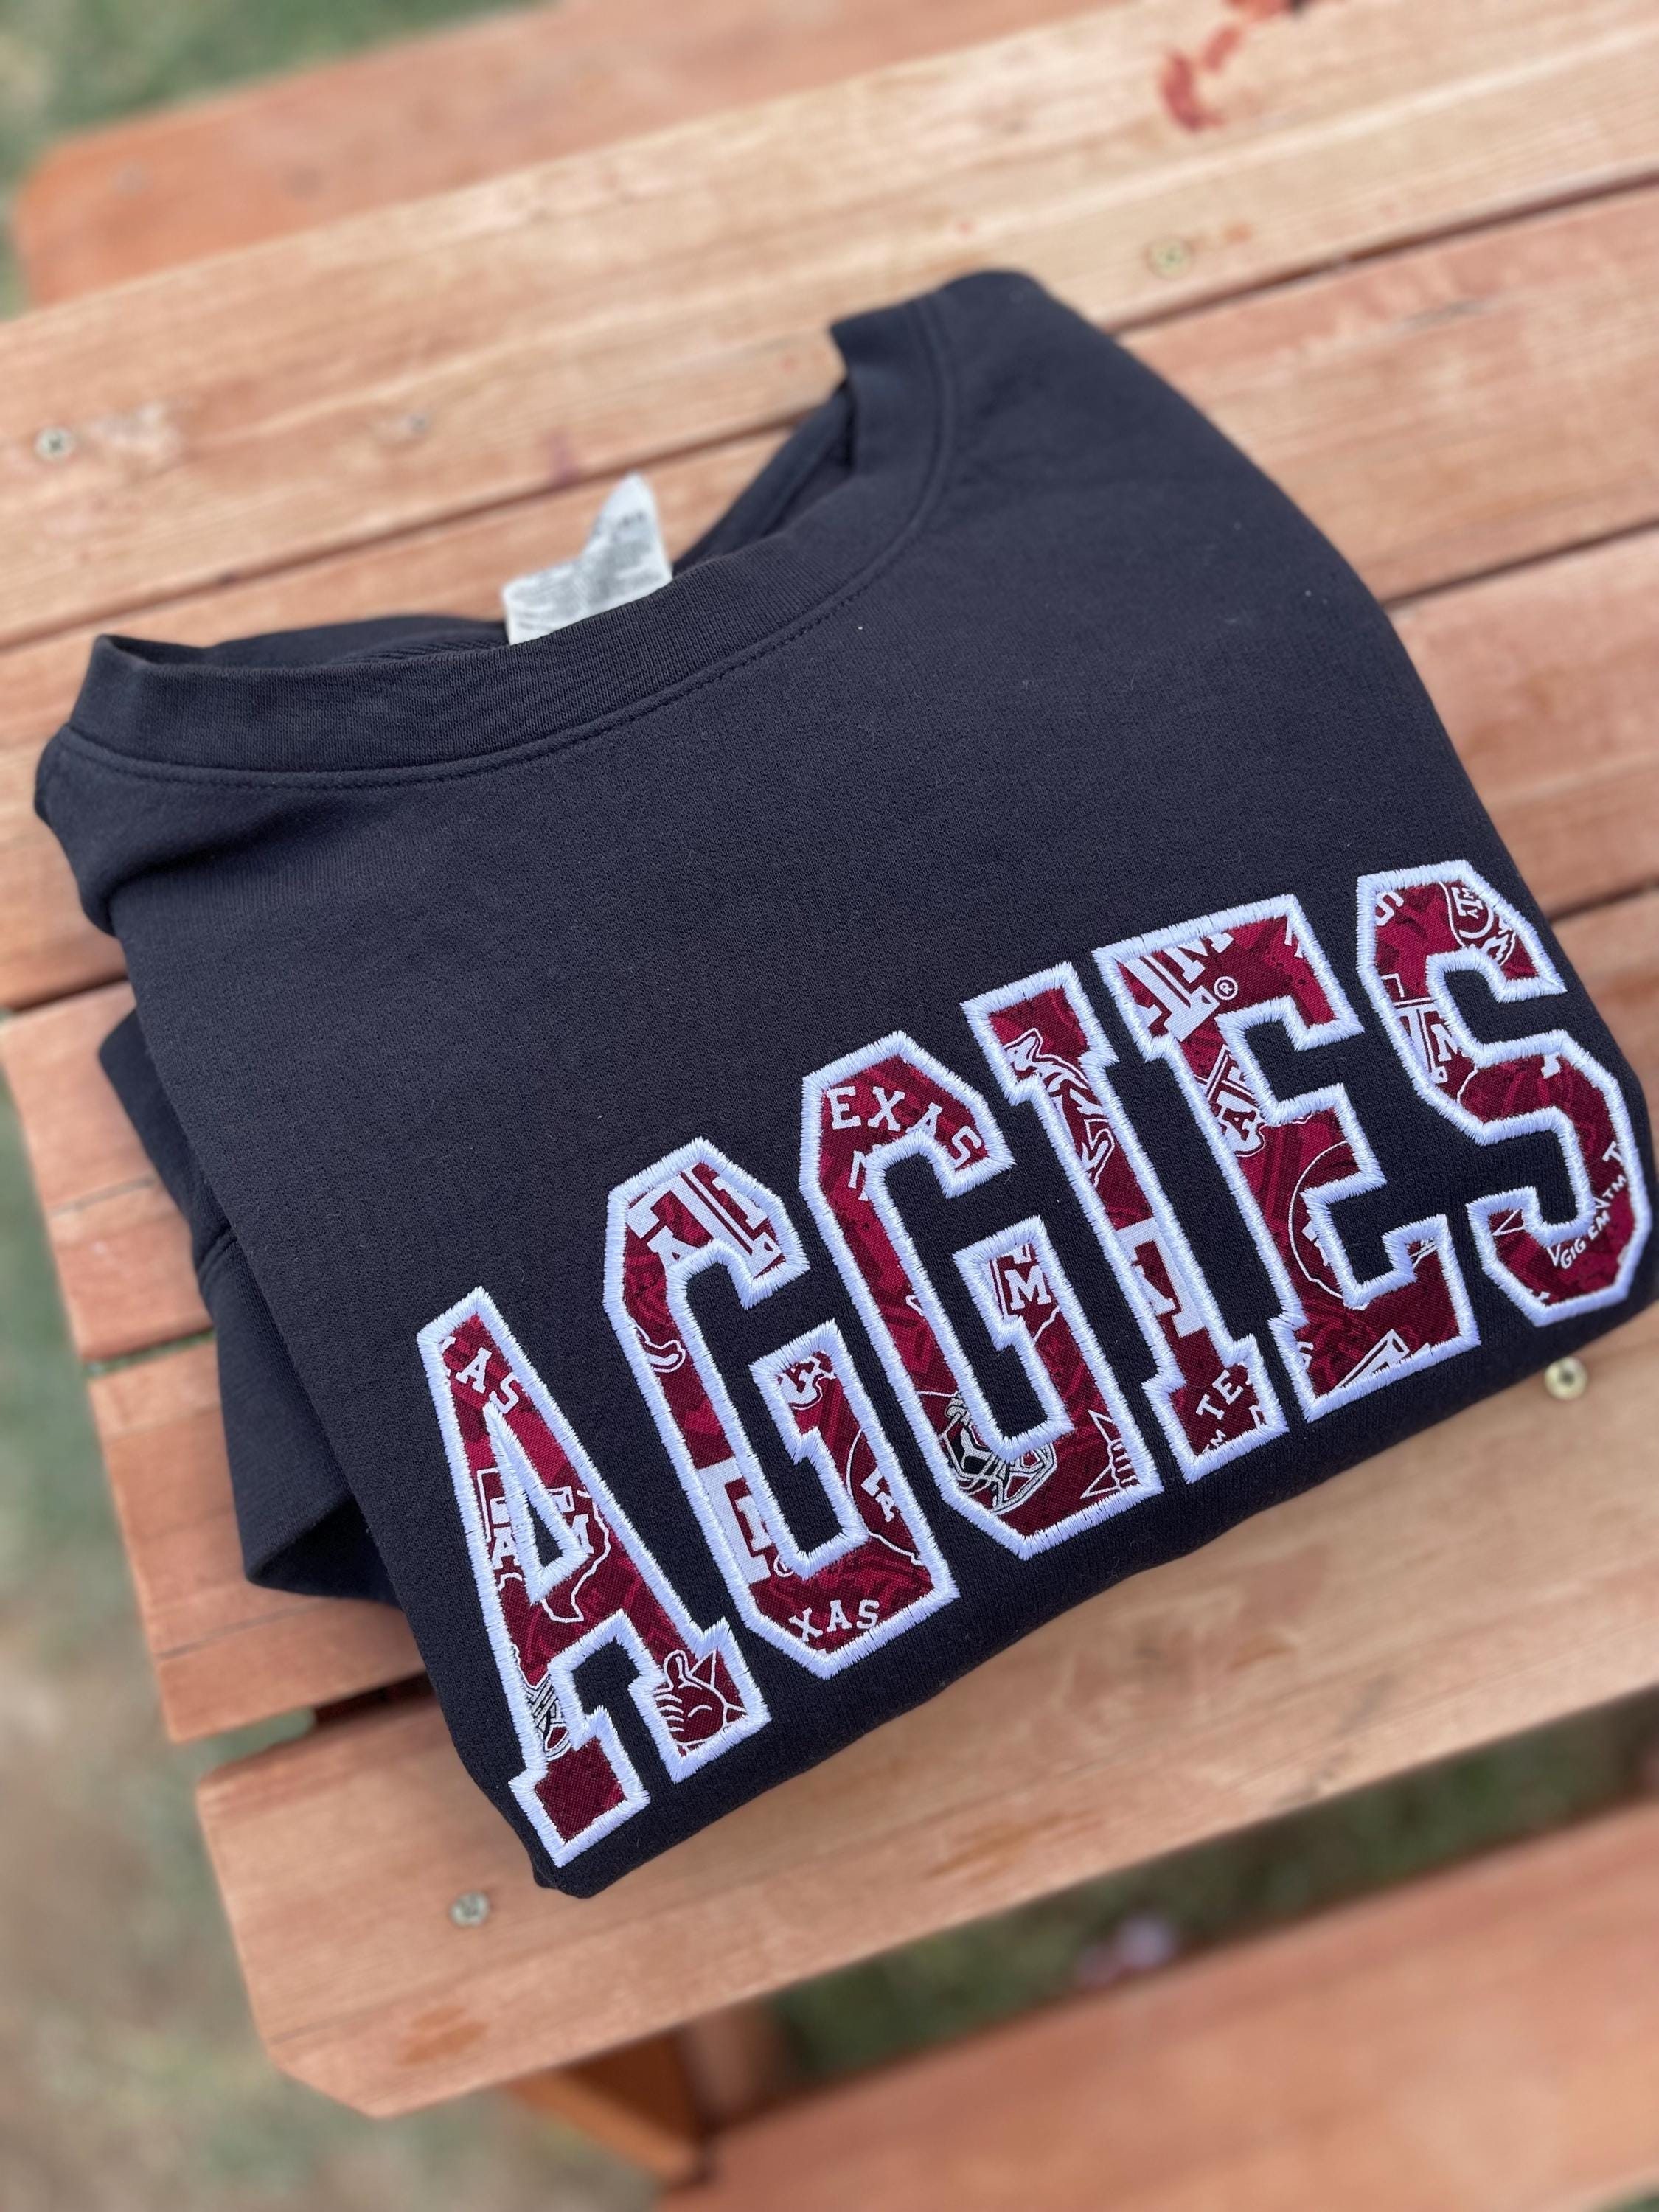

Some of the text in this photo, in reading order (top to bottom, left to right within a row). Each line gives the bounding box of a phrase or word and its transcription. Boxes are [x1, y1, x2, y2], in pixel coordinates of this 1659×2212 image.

[827, 1086, 982, 1170] EXAS
[417, 859, 1652, 1866] AGGIES
[788, 1599, 880, 1642] XAS
